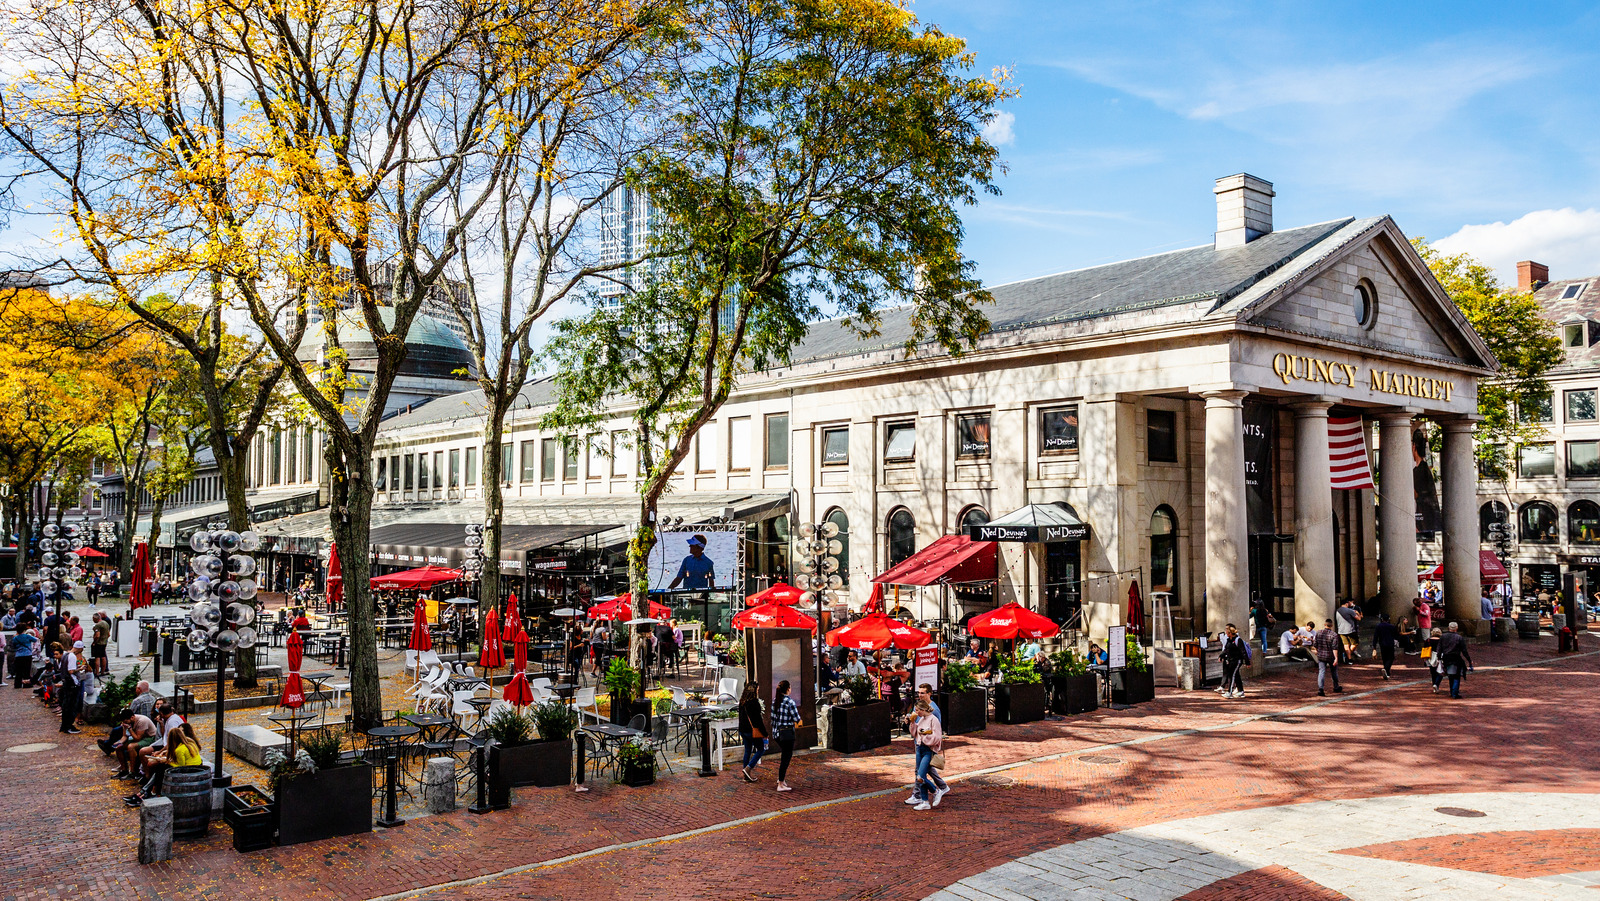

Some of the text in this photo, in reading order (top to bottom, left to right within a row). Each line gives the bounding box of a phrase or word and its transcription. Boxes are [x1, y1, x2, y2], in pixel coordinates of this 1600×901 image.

[1273, 353, 1454, 402] QUINCY MARKET
[981, 527, 1027, 540] Ned Devine's
[1047, 525, 1086, 540] Ned Devine's
[535, 561, 567, 569] wagamama
